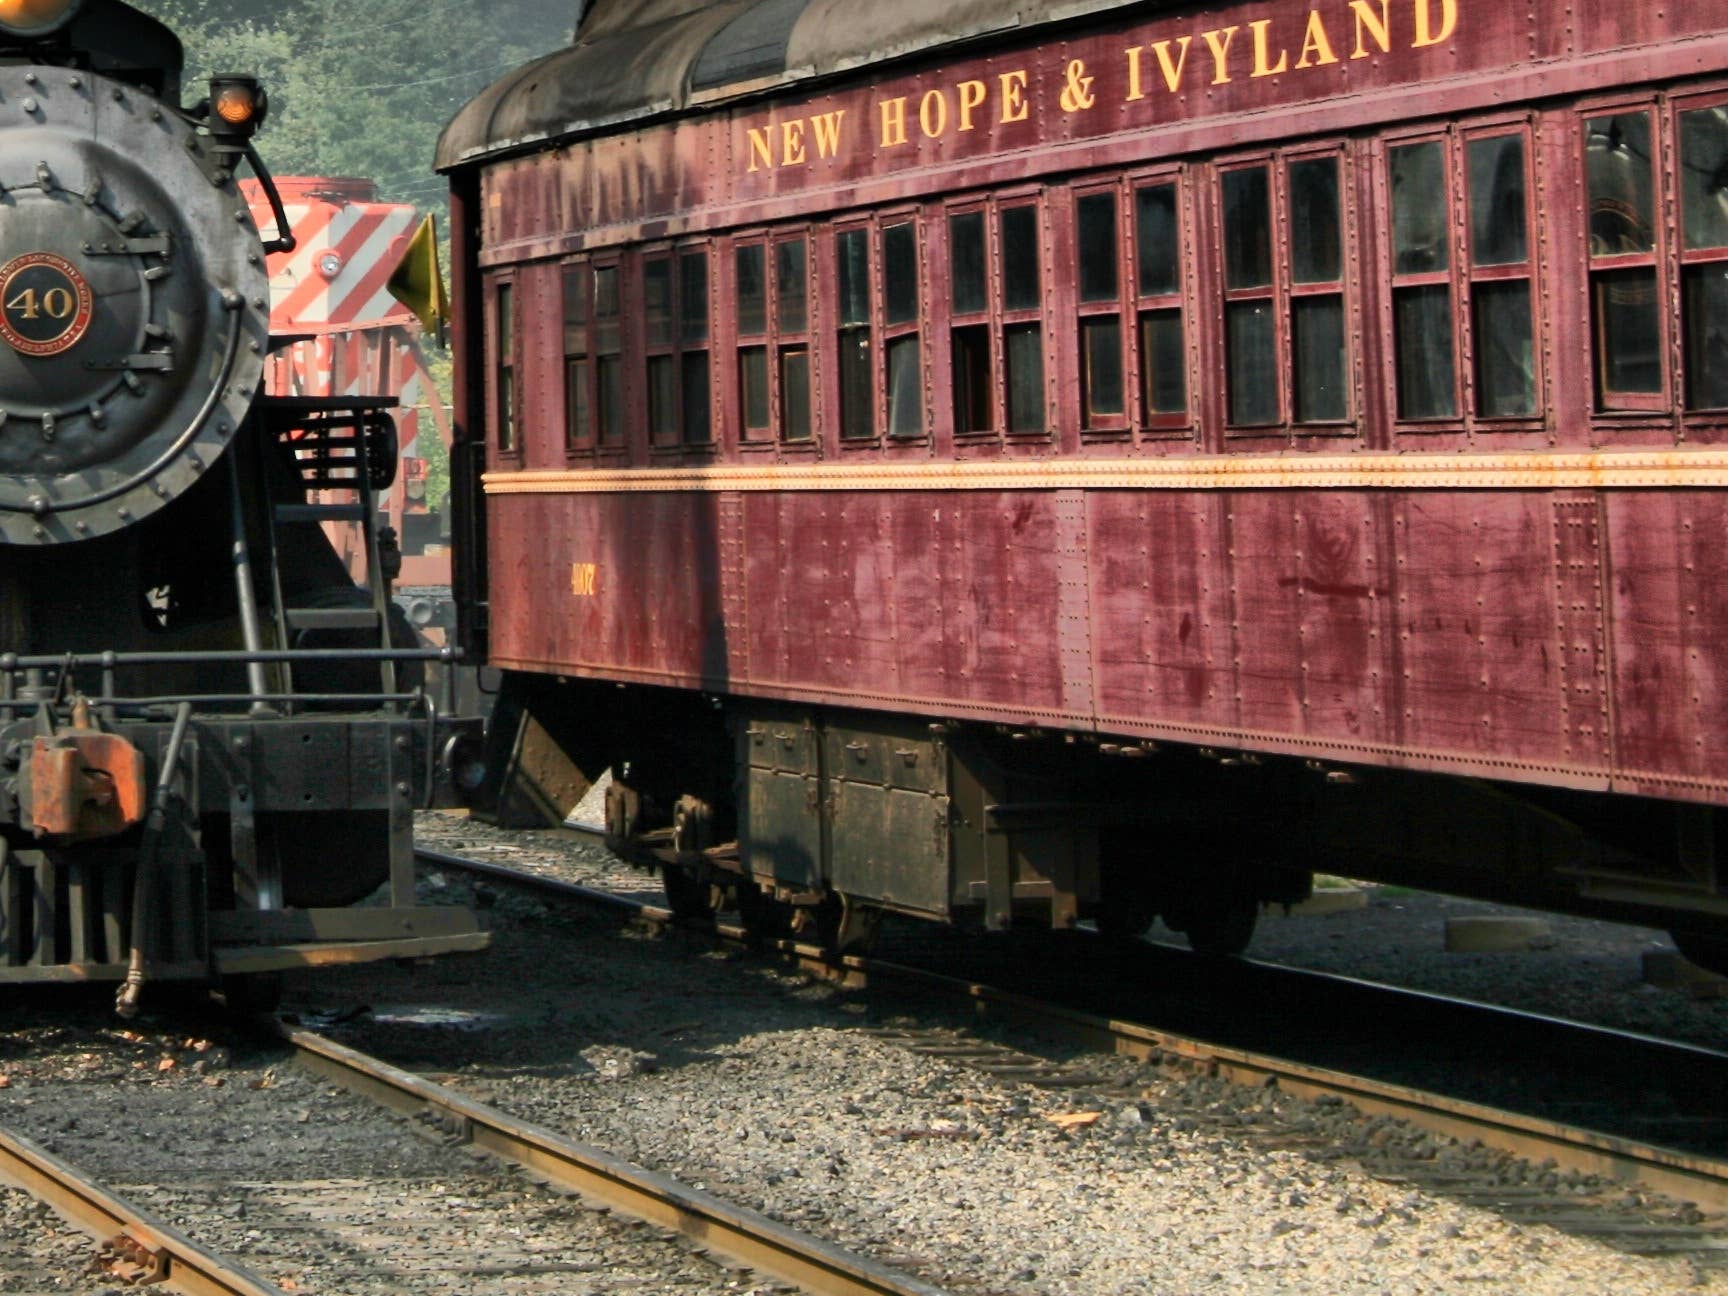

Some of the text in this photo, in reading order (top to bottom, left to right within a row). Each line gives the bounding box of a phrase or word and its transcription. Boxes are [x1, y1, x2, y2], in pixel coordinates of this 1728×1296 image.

[745, 110, 847, 173] NEW
[879, 70, 1028, 148] HOPE
[1060, 59, 1095, 113] &
[6, 288, 73, 319] 40
